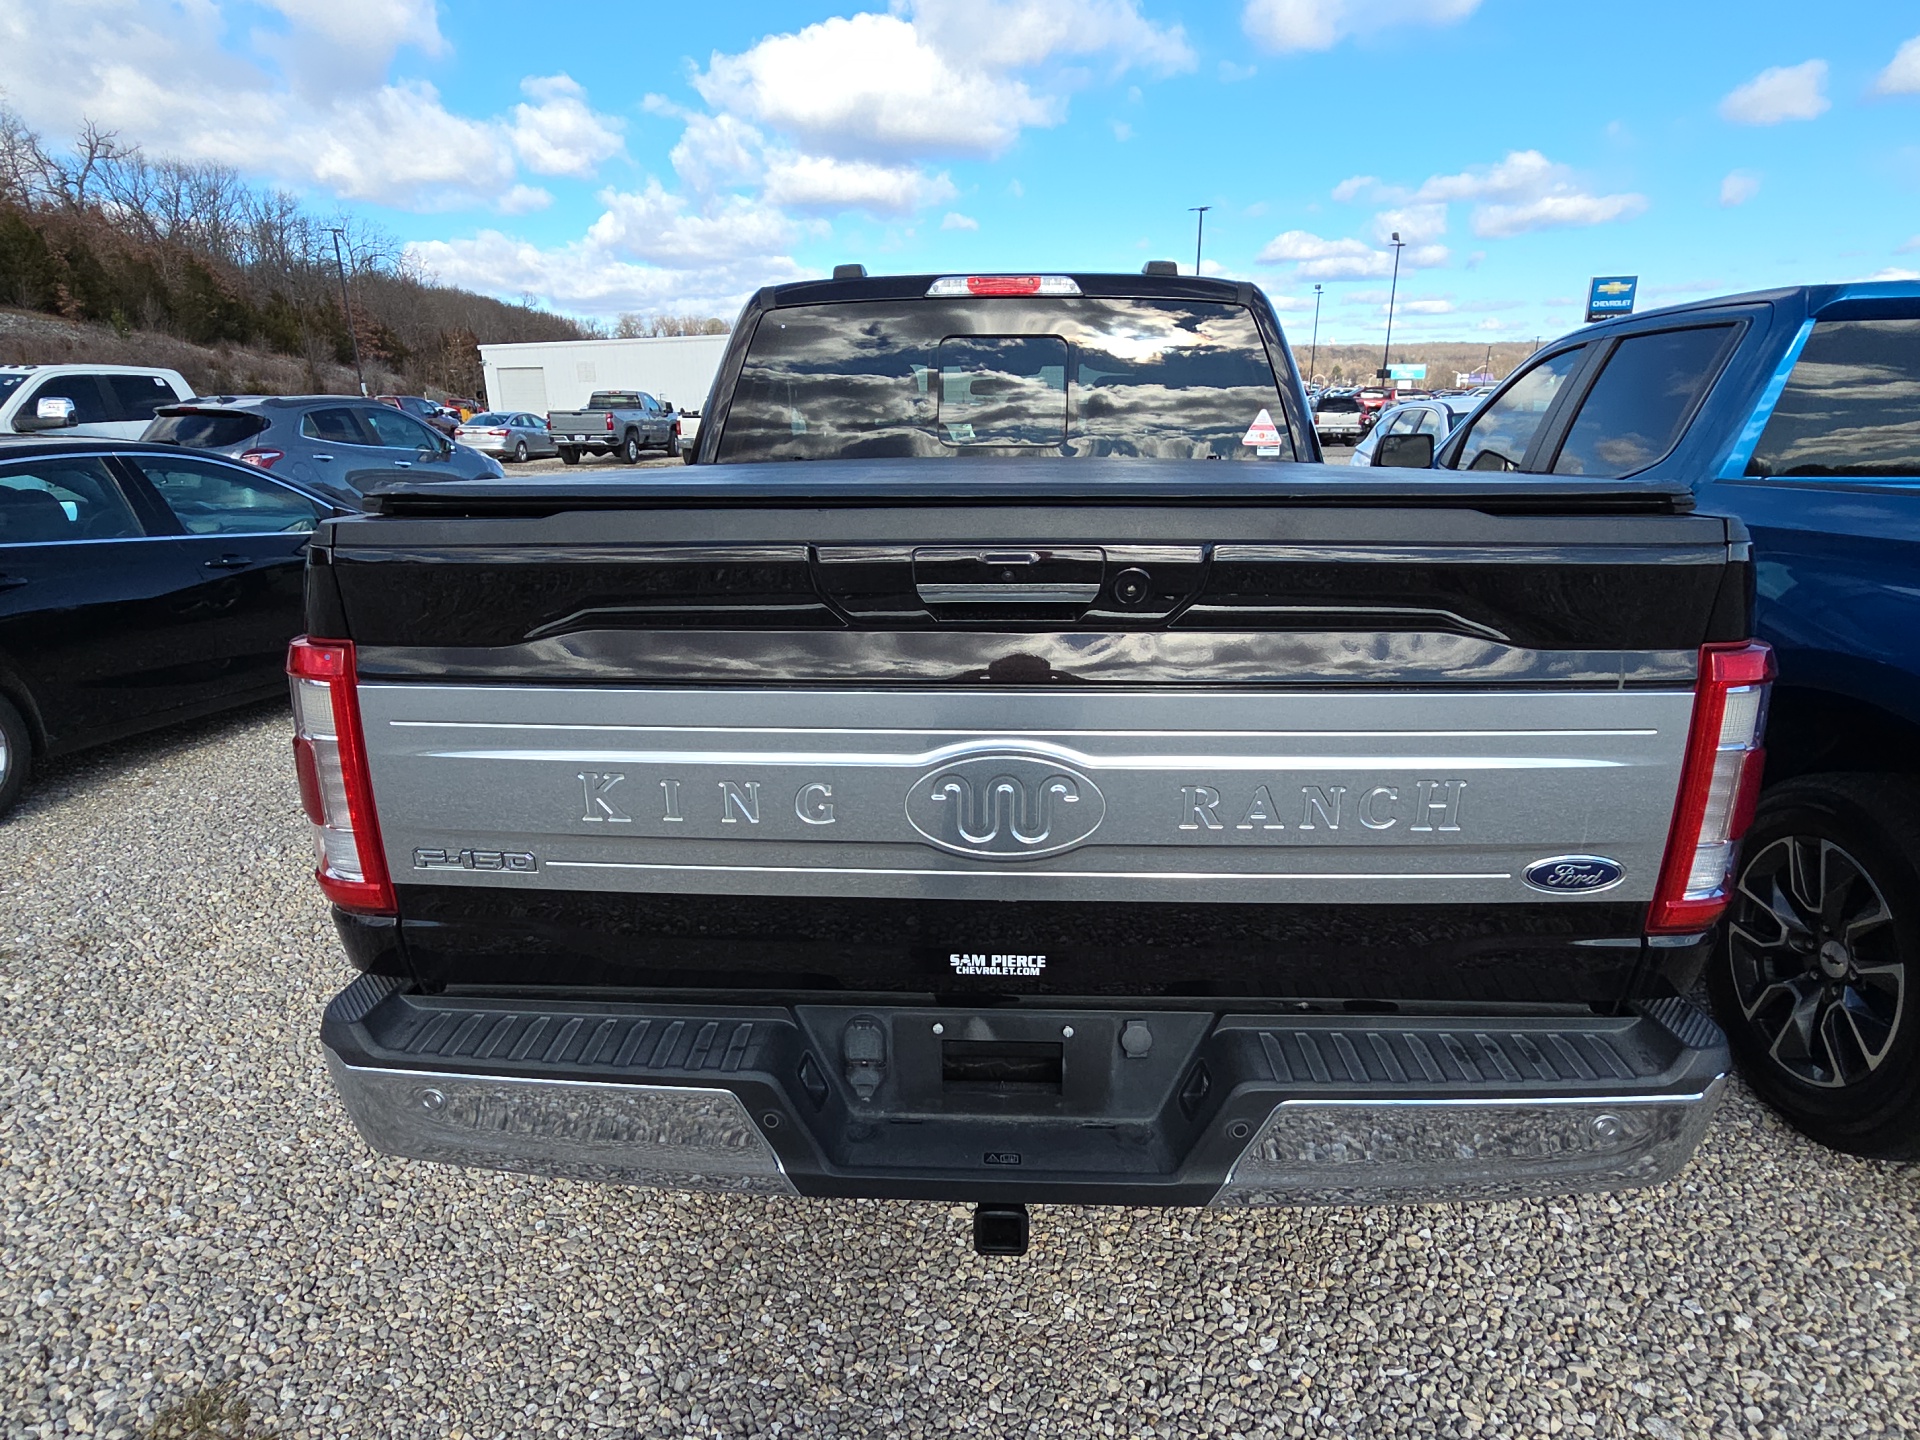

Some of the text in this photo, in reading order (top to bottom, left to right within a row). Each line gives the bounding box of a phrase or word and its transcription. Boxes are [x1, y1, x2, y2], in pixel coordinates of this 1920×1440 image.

[577, 771, 1467, 831] KING RANCH
[412, 848, 538, 872] F-150
[1546, 864, 1604, 886] Ford
[949, 954, 1046, 968] SAM PIERCE
[956, 966, 1040, 976] CHEVROLET.COM
